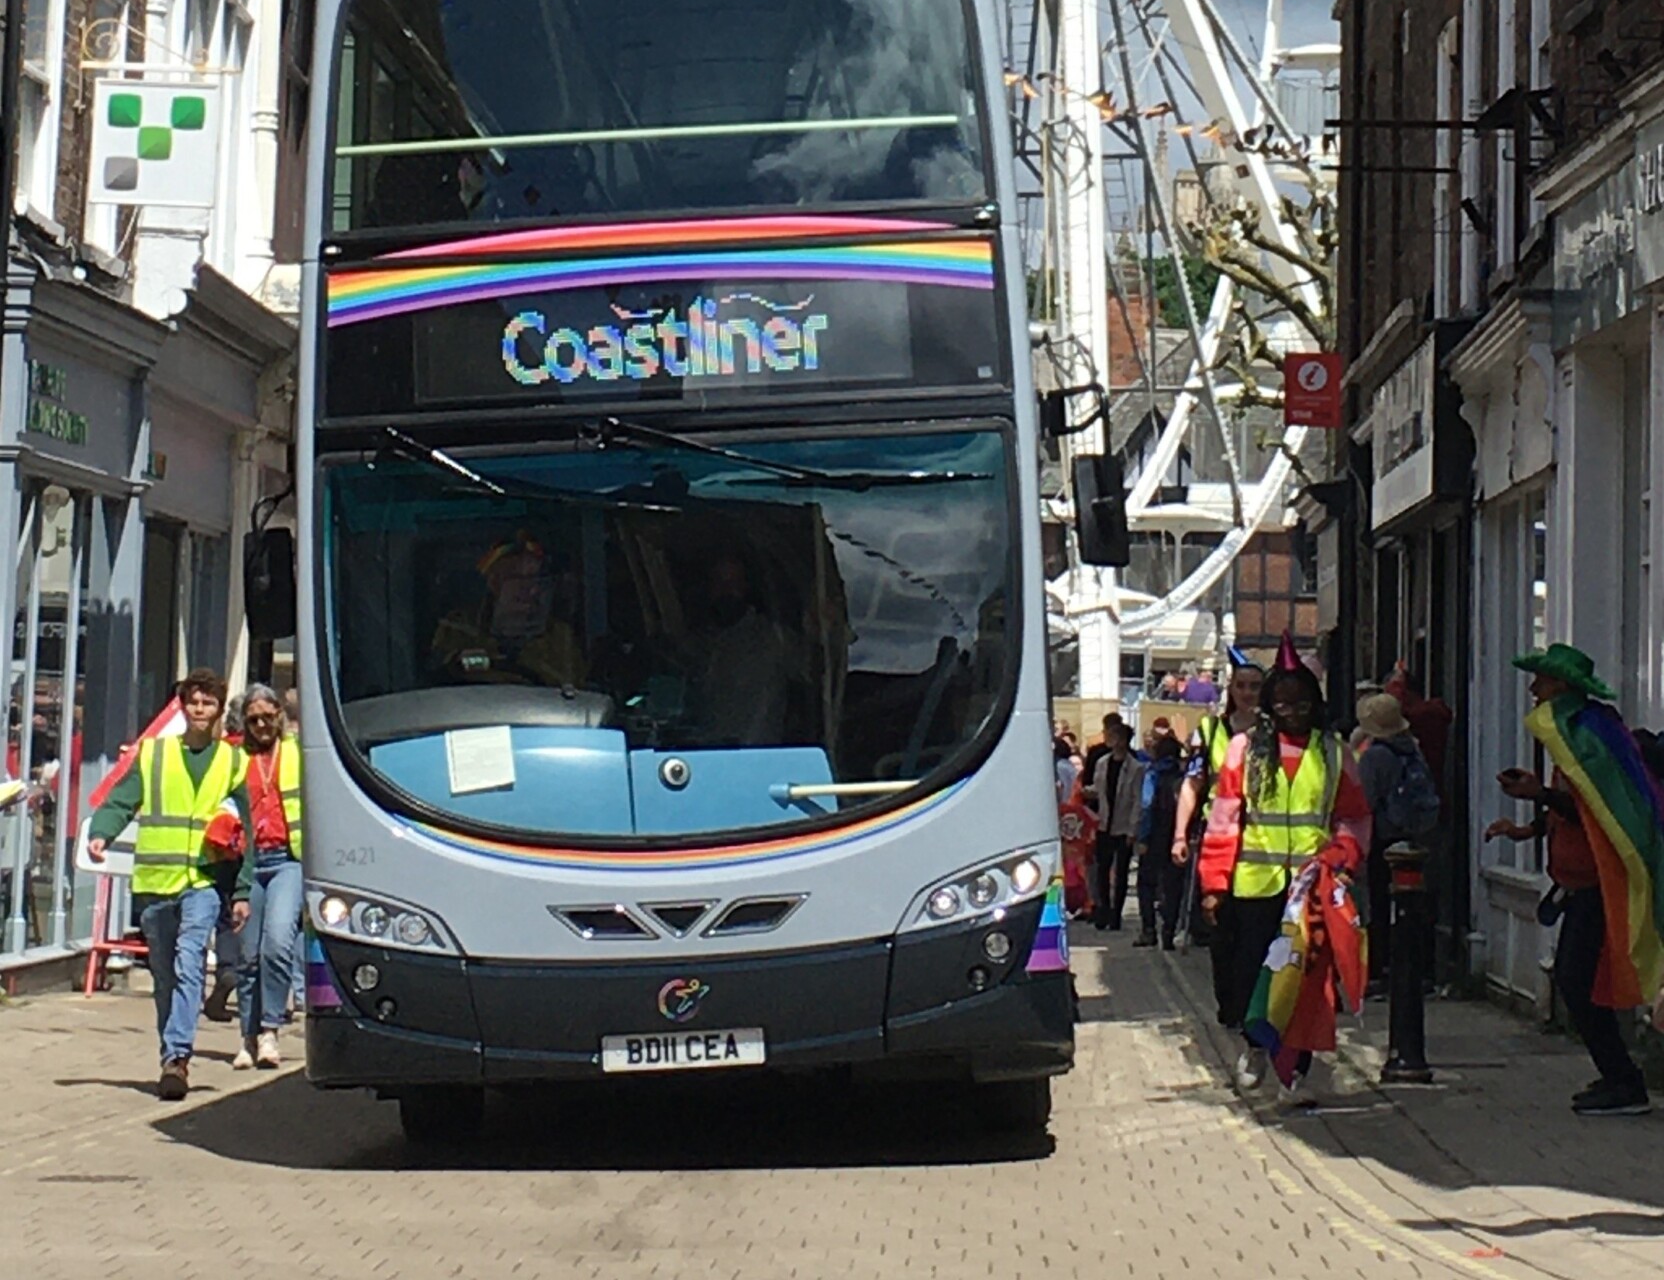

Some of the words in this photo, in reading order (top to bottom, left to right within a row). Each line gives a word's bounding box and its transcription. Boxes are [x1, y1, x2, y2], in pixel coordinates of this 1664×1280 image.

[502, 296, 828, 384] Coastliner
[335, 845, 376, 867] 2421
[626, 1036, 677, 1065] BD11
[685, 1032, 740, 1062] CEA
